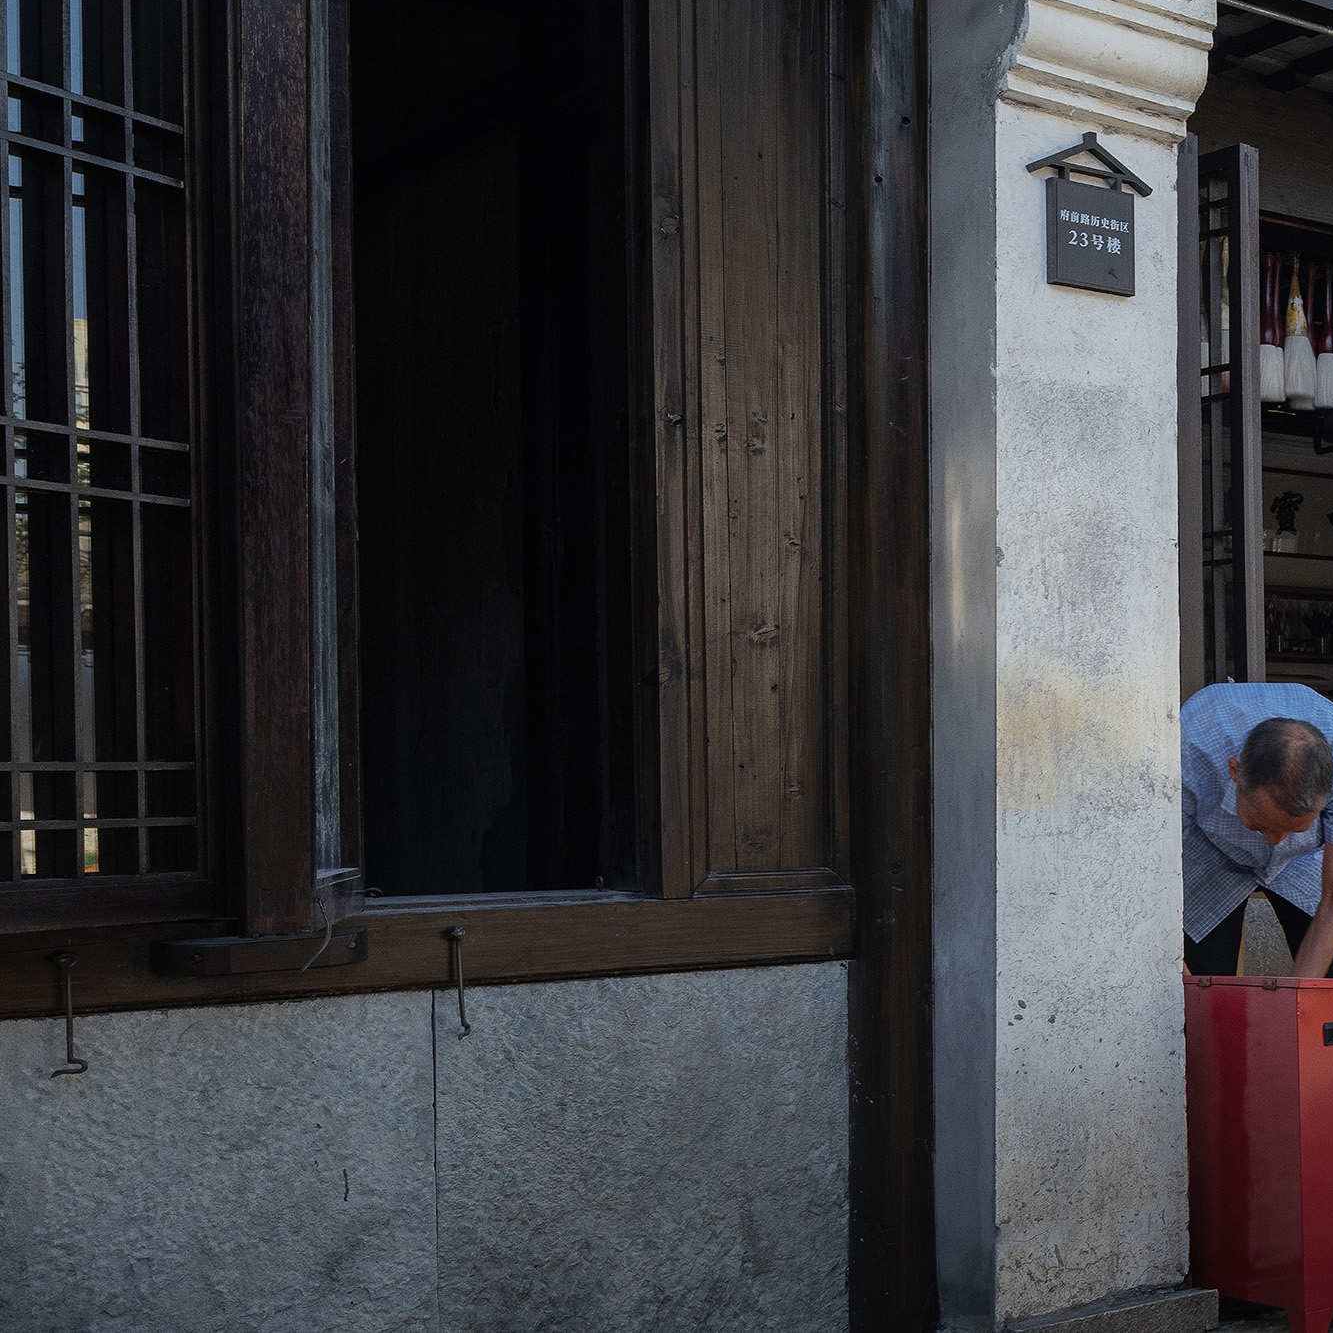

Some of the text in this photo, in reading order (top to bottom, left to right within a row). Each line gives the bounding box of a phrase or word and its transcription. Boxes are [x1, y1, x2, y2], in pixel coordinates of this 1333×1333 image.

[1060, 209, 1130, 234] 府前路历史街区
[1068, 229, 1122, 255] 23号楼
